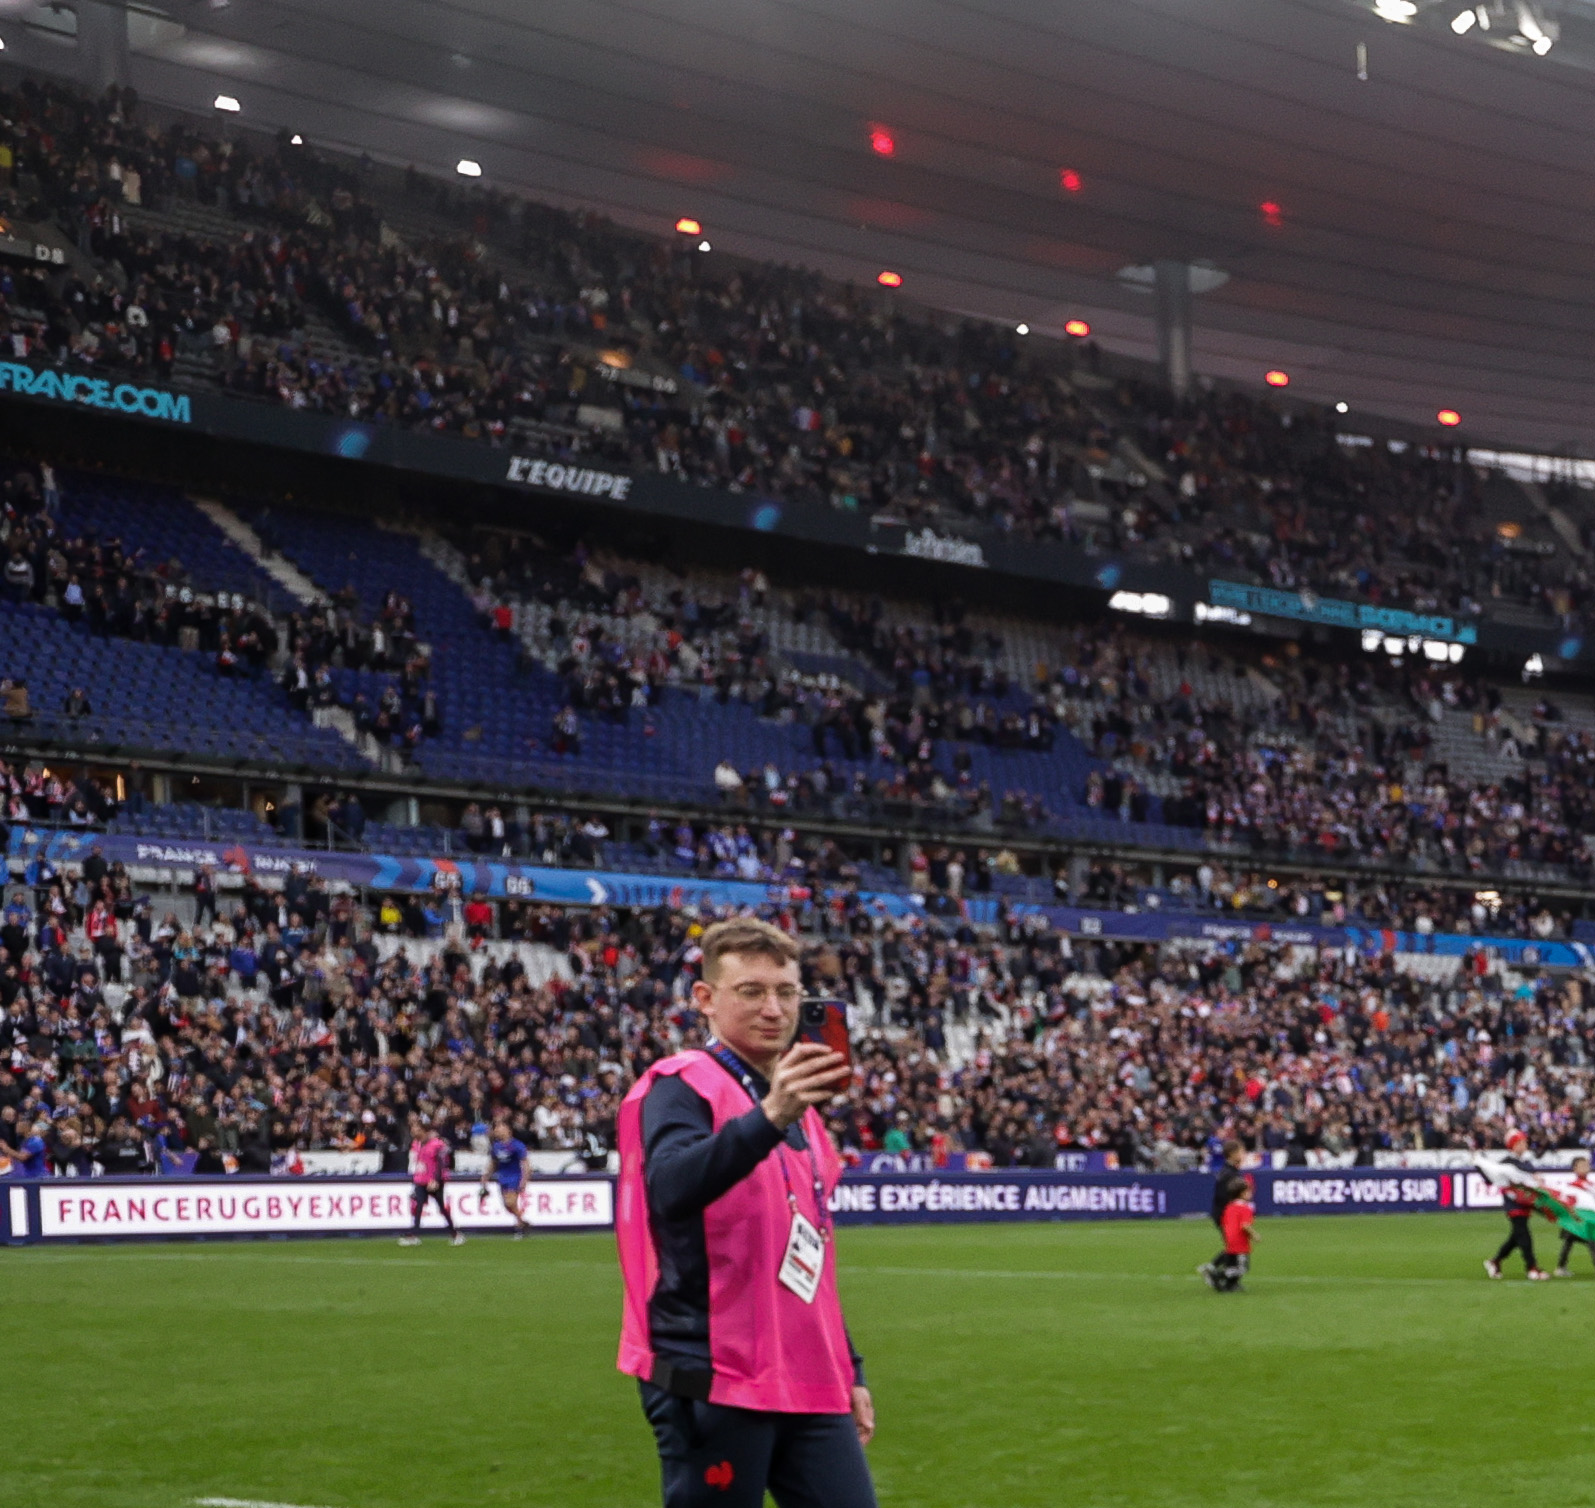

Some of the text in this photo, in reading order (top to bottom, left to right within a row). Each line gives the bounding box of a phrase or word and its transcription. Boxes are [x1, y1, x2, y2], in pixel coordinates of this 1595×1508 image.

[879, 1180, 1021, 1212] EXPÉRIENCE
[1023, 1183, 1155, 1213] AUGMENTÉE
[1273, 1177, 1438, 1204] RENDEZ-VOUS SUR
